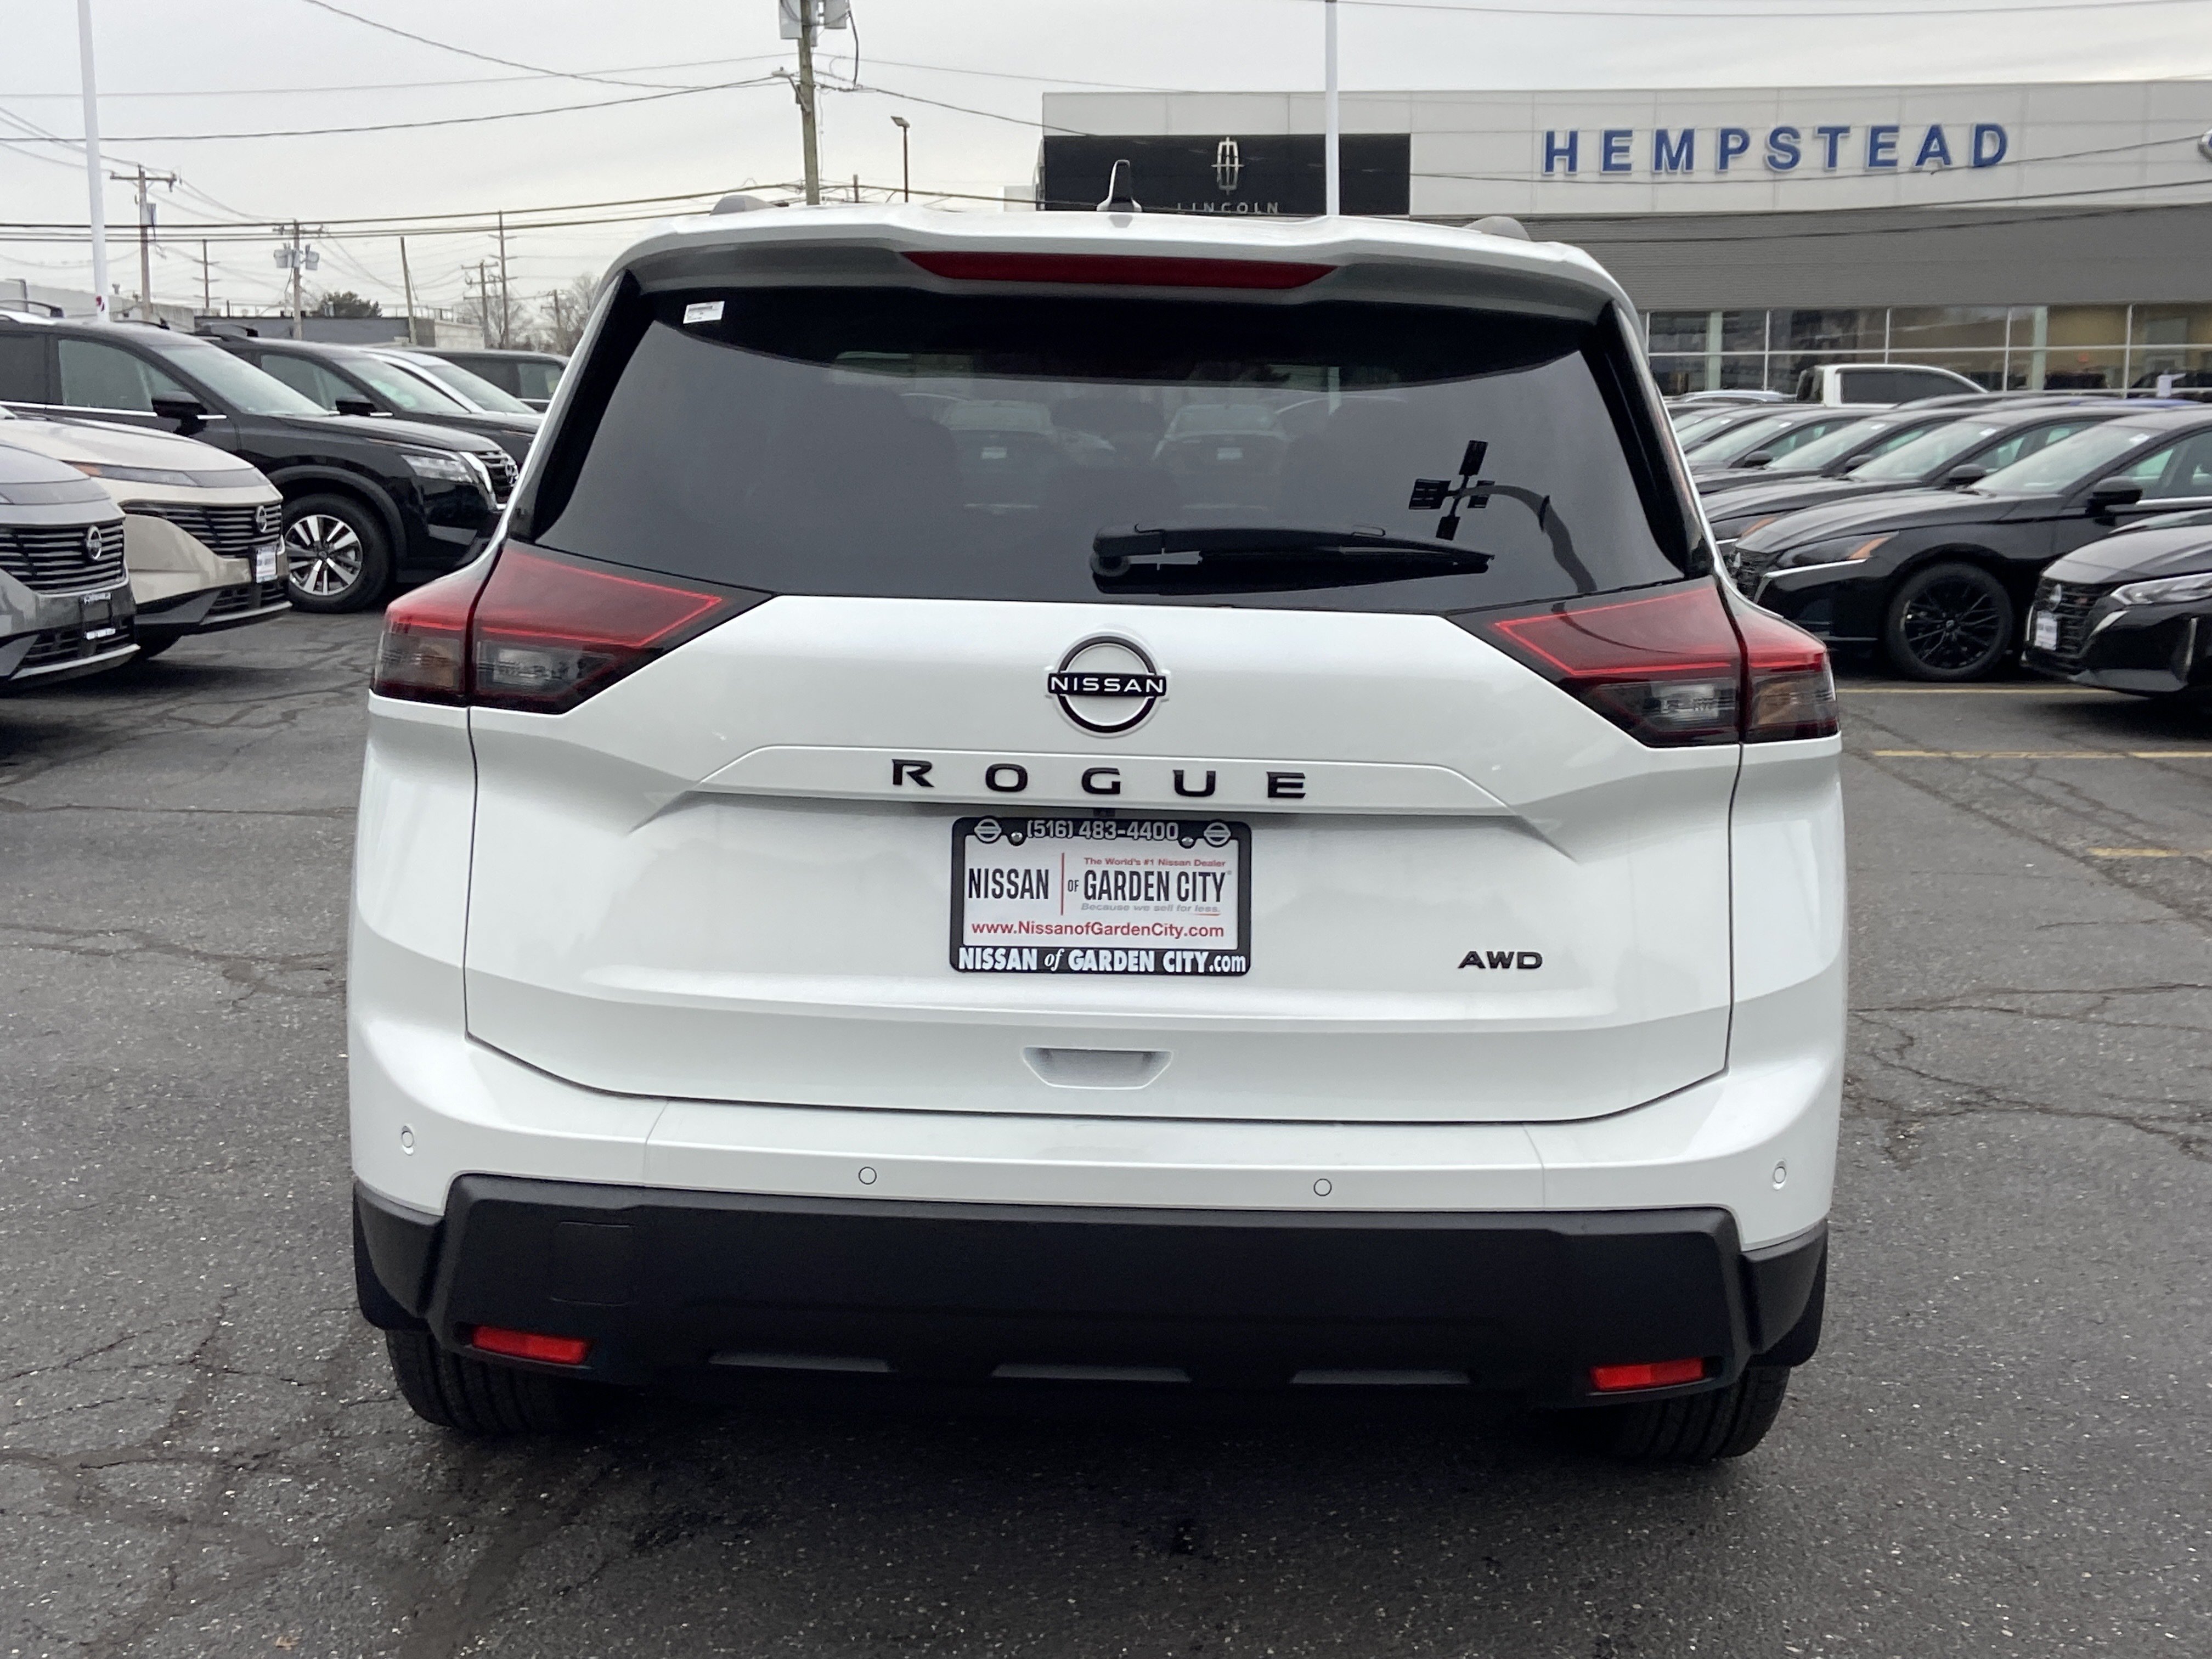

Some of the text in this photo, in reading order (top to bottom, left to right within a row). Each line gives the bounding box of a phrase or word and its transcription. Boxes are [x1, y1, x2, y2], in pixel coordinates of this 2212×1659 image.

[1543, 122, 2009, 176] HEMPSTEAD
[1051, 676, 1164, 693] NISSAN
[891, 759, 1306, 798] ROGUE
[1027, 820, 1179, 840] (516) 483-4400
[968, 868, 1226, 902] NISSAN OF GARDEN CITY
[1081, 902, 1130, 911] Because
[1154, 904, 1173, 912] sell
[1176, 904, 1192, 912] for
[972, 921, 1224, 939] www.NissanofGardenCity.com
[958, 947, 1246, 973] NISSAN of GARDEN CITY.com
[1457, 951, 1543, 969] AWD
